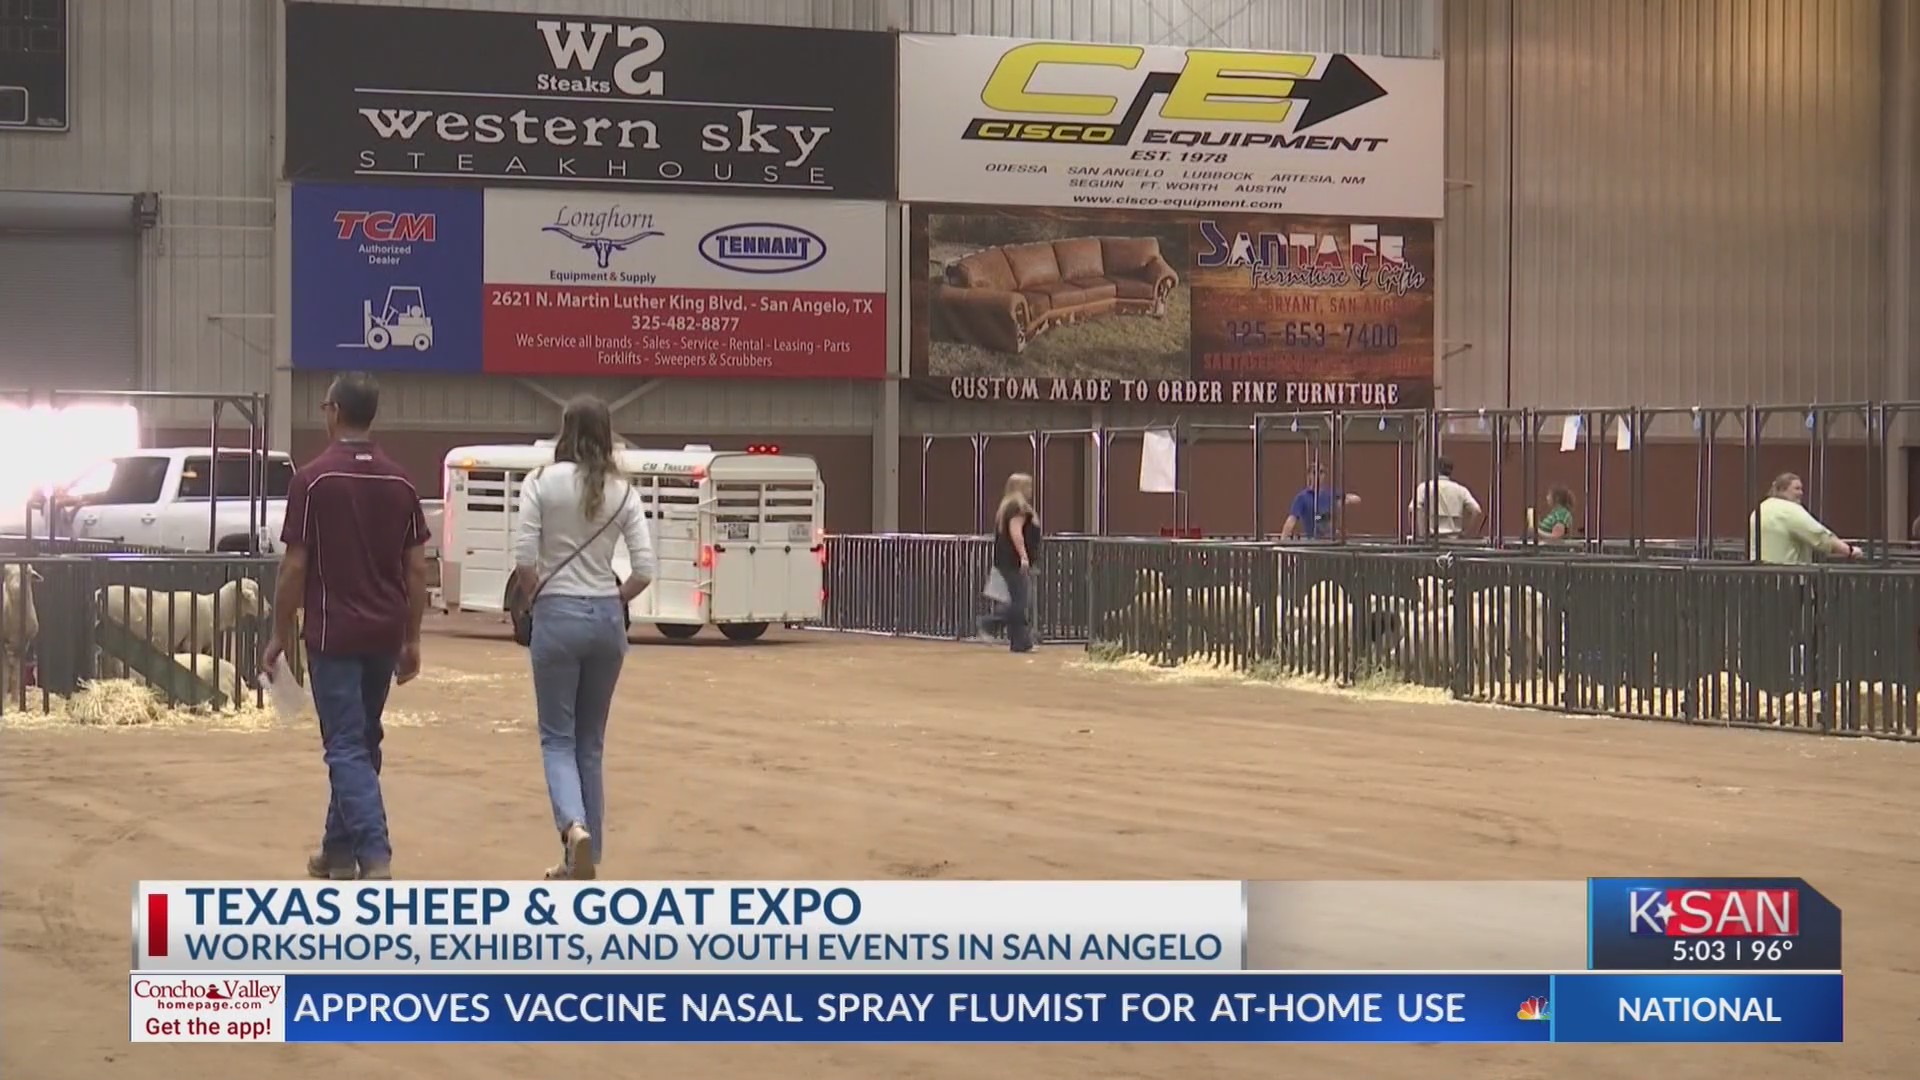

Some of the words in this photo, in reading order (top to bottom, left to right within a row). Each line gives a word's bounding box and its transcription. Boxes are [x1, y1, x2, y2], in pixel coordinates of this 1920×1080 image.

[537, 74, 611, 93] Steaks
[357, 108, 662, 149] western
[701, 108, 831, 167] sky
[977, 122, 1116, 143] CISCO
[1142, 128, 1389, 152] EQUIPMENT
[359, 150, 826, 184] STEAKHOUSE
[1130, 150, 1171, 162] EST.
[1180, 151, 1228, 164] 1978
[985, 163, 1048, 174] ODESSA
[1067, 166, 1099, 176] SAN
[1102, 167, 1164, 178] ANGELO
[1183, 170, 1254, 181] LUBBOCK
[1341, 176, 1366, 185] NM
[1069, 178, 1124, 188] SEGUIN
[1140, 181, 1161, 190] FT.
[1166, 182, 1218, 192] WORTH
[1235, 184, 1287, 194] AUSTIN
[1073, 194, 1283, 209] www.cisco-equipment.com
[334, 210, 436, 242] TCM
[554, 204, 654, 236] Longhorn
[359, 244, 412, 254] Authorized
[715, 235, 811, 260] TENNANT
[1198, 220, 1344, 270] SANTA
[1350, 224, 1405, 270] FE
[368, 255, 400, 264] Dealer
[549, 270, 608, 283] Equipment
[609, 272, 617, 281] &
[619, 272, 657, 284] Supply
[1250, 261, 1347, 288] Furniture
[1353, 267, 1371, 288] &
[1375, 264, 1424, 296] Gifts
[492, 291, 530, 306] 2621
[536, 293, 553, 307] N.
[557, 292, 609, 308] Martin
[614, 293, 666, 310] Luther
[670, 295, 704, 313] King
[708, 295, 748, 311] Blvd.
[760, 297, 788, 312] San
[792, 298, 850, 316] Angelo,
[853, 300, 873, 313] TX
[631, 315, 740, 331] 325-482-8877
[516, 333, 534, 347] We
[537, 335, 577, 348] Service
[578, 334, 593, 348] all
[595, 335, 632, 349] brands
[642, 336, 671, 350] Sales
[681, 336, 719, 350] Service
[729, 338, 764, 351] Rental
[774, 339, 814, 354] Leasing
[824, 340, 850, 352] Parts
[1227, 321, 1398, 349] 325-653-7400
[598, 351, 642, 365] Forklifts
[654, 352, 707, 368] Sweepers
[709, 355, 718, 366] &
[720, 354, 773, 367] Scrubbers
[951, 376, 1040, 400] CUSTOM
[1050, 378, 1111, 401] MADE
[1120, 379, 1149, 401] TO
[1157, 379, 1223, 403] ORDER
[1231, 382, 1278, 403] FINE
[1286, 382, 1400, 405] FURNITURE
[642, 462, 658, 471] CM
